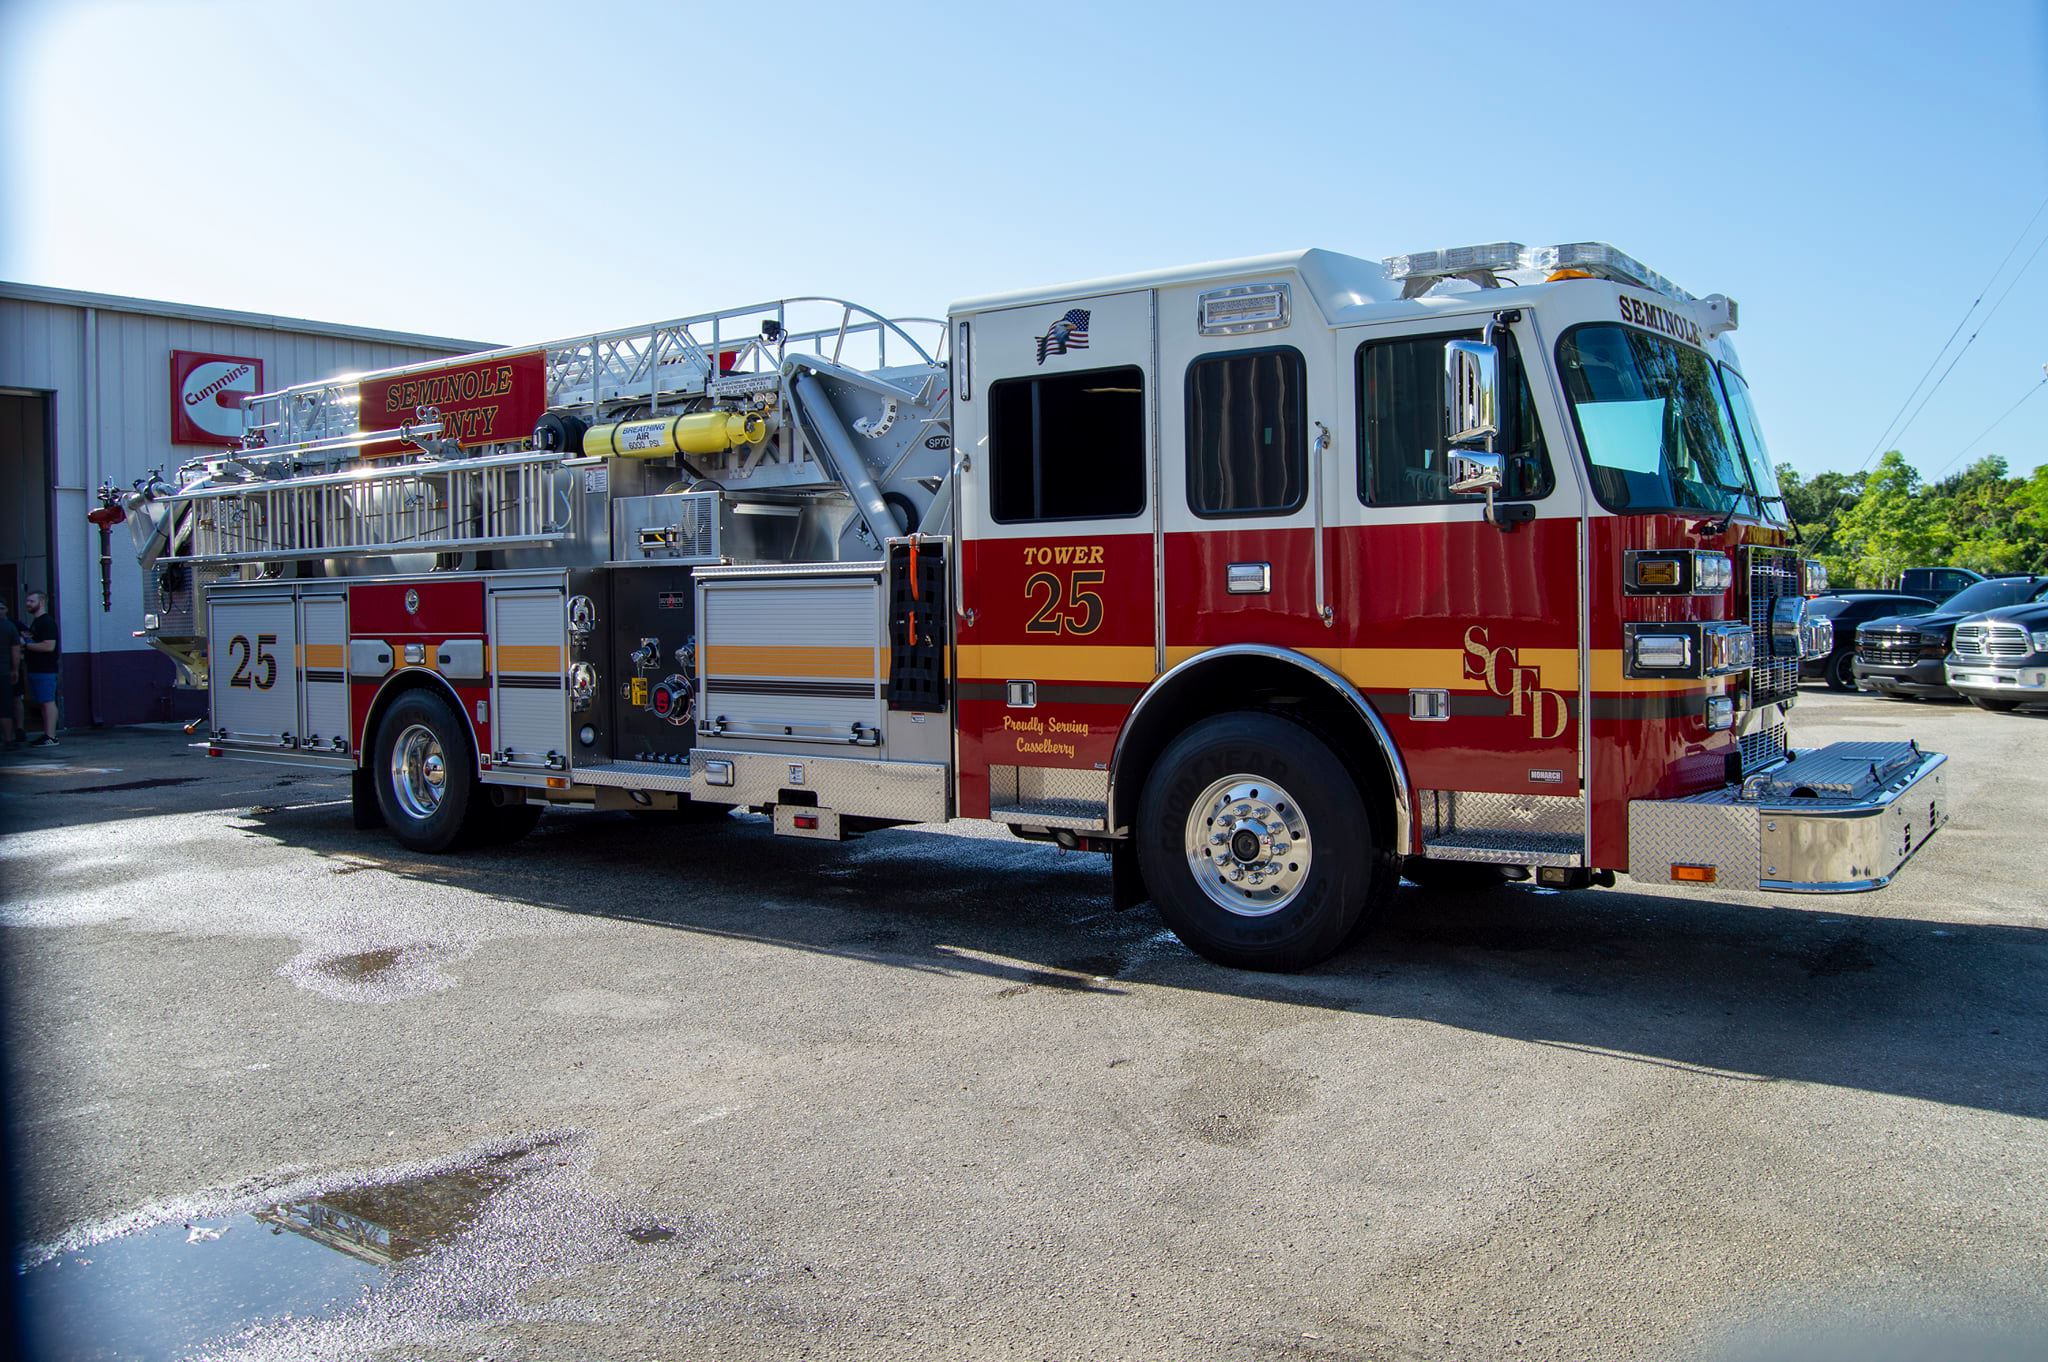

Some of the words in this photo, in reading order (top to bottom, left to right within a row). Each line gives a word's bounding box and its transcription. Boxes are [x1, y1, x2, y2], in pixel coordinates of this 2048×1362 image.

[1619, 294, 1701, 347] SEMINOLE
[184, 363, 249, 406] Cummins
[386, 365, 513, 413] SEMINOLE
[889, 404, 897, 413] 80
[622, 423, 666, 435] BREATHING
[636, 432, 650, 441] AIR
[628, 440, 646, 450] 6000
[1023, 545, 1105, 566] TOWER
[1024, 569, 1105, 636] 25
[228, 632, 277, 692] 25
[1464, 625, 1568, 740] SCFD
[1003, 715, 1044, 736] Proudly
[1048, 716, 1089, 737] Serving
[1016, 737, 1075, 759] Casselberry
[1531, 770, 1561, 780] MONARCH
